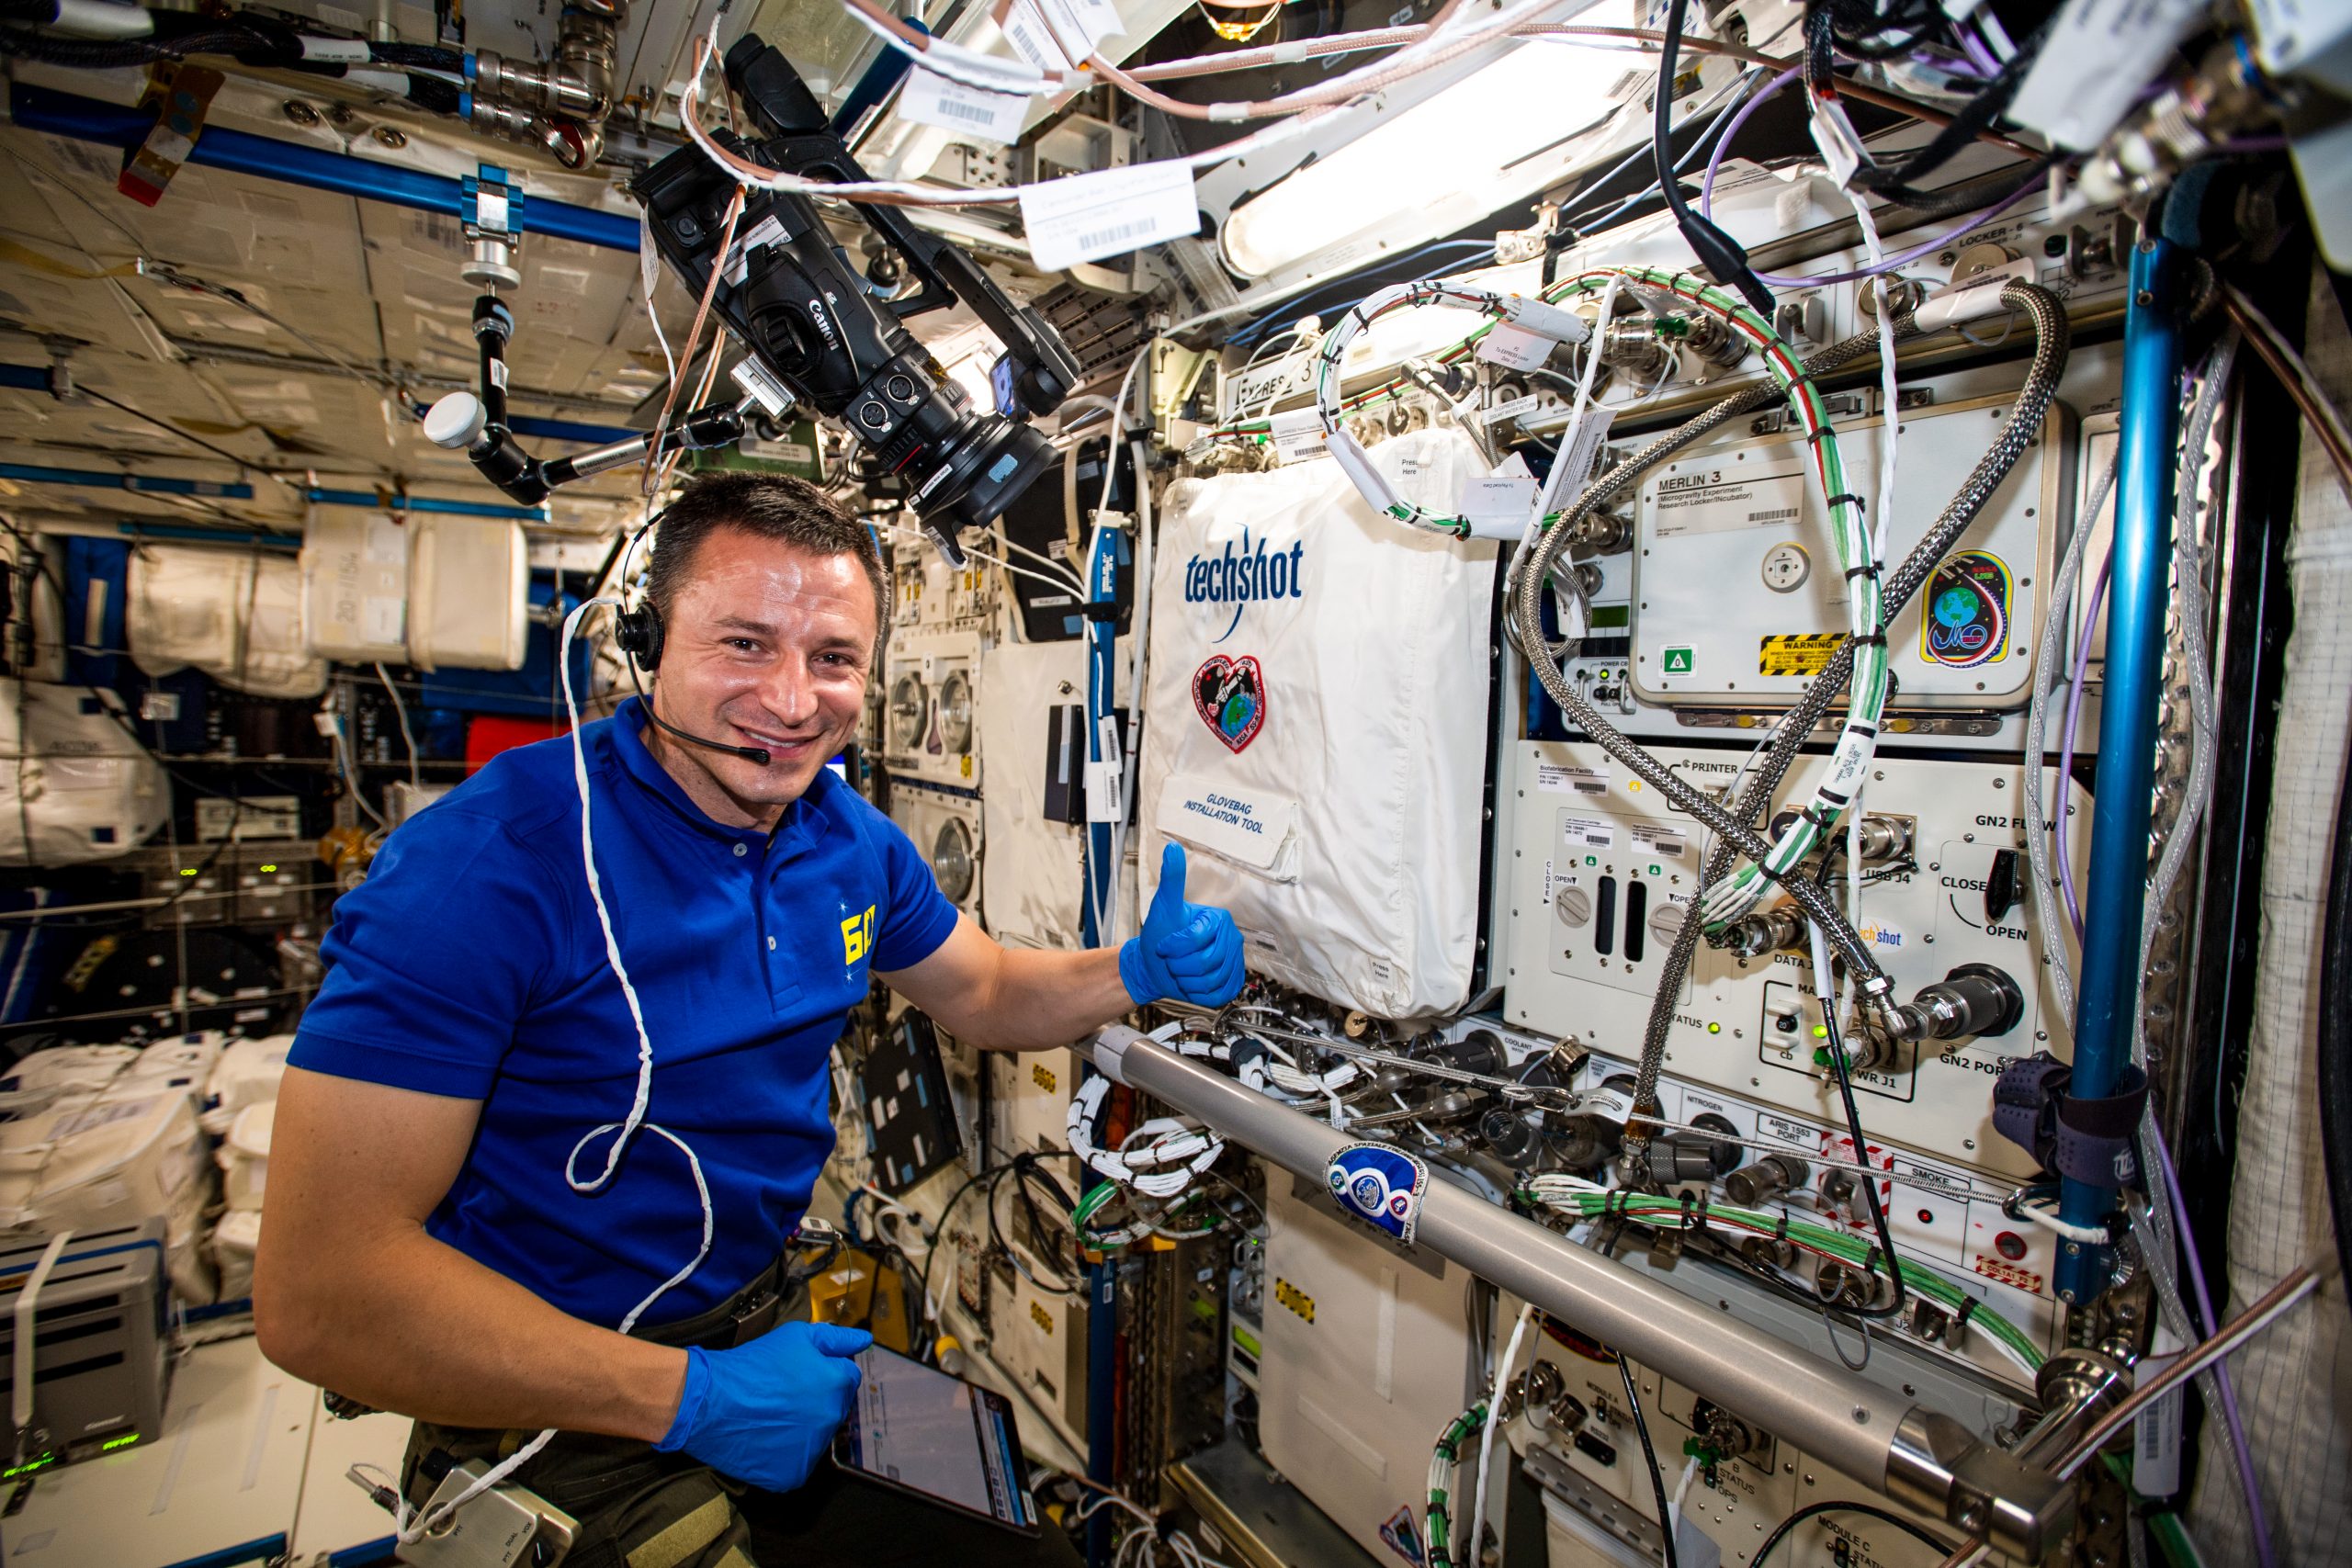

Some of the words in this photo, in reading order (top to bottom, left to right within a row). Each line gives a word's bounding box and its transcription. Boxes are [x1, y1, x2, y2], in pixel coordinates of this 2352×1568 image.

[1959, 228, 2006, 247] LOCKER
[2017, 222, 2024, 232] 6
[1801, 289, 1822, 299] POWER
[808, 299, 840, 351] Canon
[1500, 349, 1517, 359] EXPRESS
[1517, 353, 1529, 362] Locker
[1499, 402, 1515, 412] EXPRESS
[1658, 474, 1705, 491] MERLIN
[1711, 471, 1721, 483] 3
[1657, 491, 1701, 505] (Microgravity
[1702, 485, 1743, 498] Experiment
[1657, 500, 1689, 510] Research
[1690, 492, 1753, 507] Locker/INcubator)
[1185, 537, 1303, 603] techshot
[1784, 642, 1833, 650] WARNING
[1236, 732, 1248, 746] NASA
[1540, 765, 1575, 774] Biofabrication
[1575, 767, 1595, 776] Facility
[1692, 762, 1738, 773] PRINTER
[1207, 793, 1252, 815] GLOVEBAG
[1183, 800, 1240, 825] INSTALLATION
[1242, 818, 1263, 834] TOOL
[1976, 815, 2007, 828] GN2
[2012, 818, 2057, 832] FLW
[1555, 875, 1572, 884] OPEN
[1866, 869, 1892, 882] USB
[1895, 874, 1911, 885] J4
[841, 904, 876, 966] 60
[1985, 925, 2028, 942] OPEN
[1372, 962, 1389, 972] Press
[1775, 953, 1806, 968] DATA
[1374, 970, 1389, 979] Here
[1671, 1013, 1703, 1029] TATUS
[1504, 1037, 1532, 1051] COOLANT
[1780, 1050, 1793, 1060] cb
[1940, 1053, 1970, 1069] GN2
[1883, 1076, 1896, 1089] J1
[1687, 1094, 1724, 1112] NITROGEN
[1769, 1118, 1790, 1132] ARIS
[1792, 1125, 1811, 1139] 1553
[1776, 1128, 1802, 1143] PORT
[1328, 1145, 1352, 1166] AGENZIA
[1354, 1141, 1386, 1150] SPAZIALE
[1912, 1167, 1950, 1185] SMOKE
[1986, 1264, 2018, 1281] COL1A1
[2018, 1275, 2029, 1284] F2
[1896, 1318, 1911, 1332] J2
[1587, 1380, 1612, 1400] MODULE
[1590, 1426, 1609, 1442] RS232
[1732, 1462, 1741, 1474] B
[1719, 1468, 1756, 1495] STATUS
[1718, 1485, 1739, 1504] OPS
[453, 1524, 464, 1536] PTT
[522, 1522, 532, 1534] VOX
[1818, 1515, 1861, 1549] MODULE
[1862, 1540, 1871, 1553] C
[506, 1532, 518, 1547] DUAL
[503, 1551, 512, 1563] PTT
